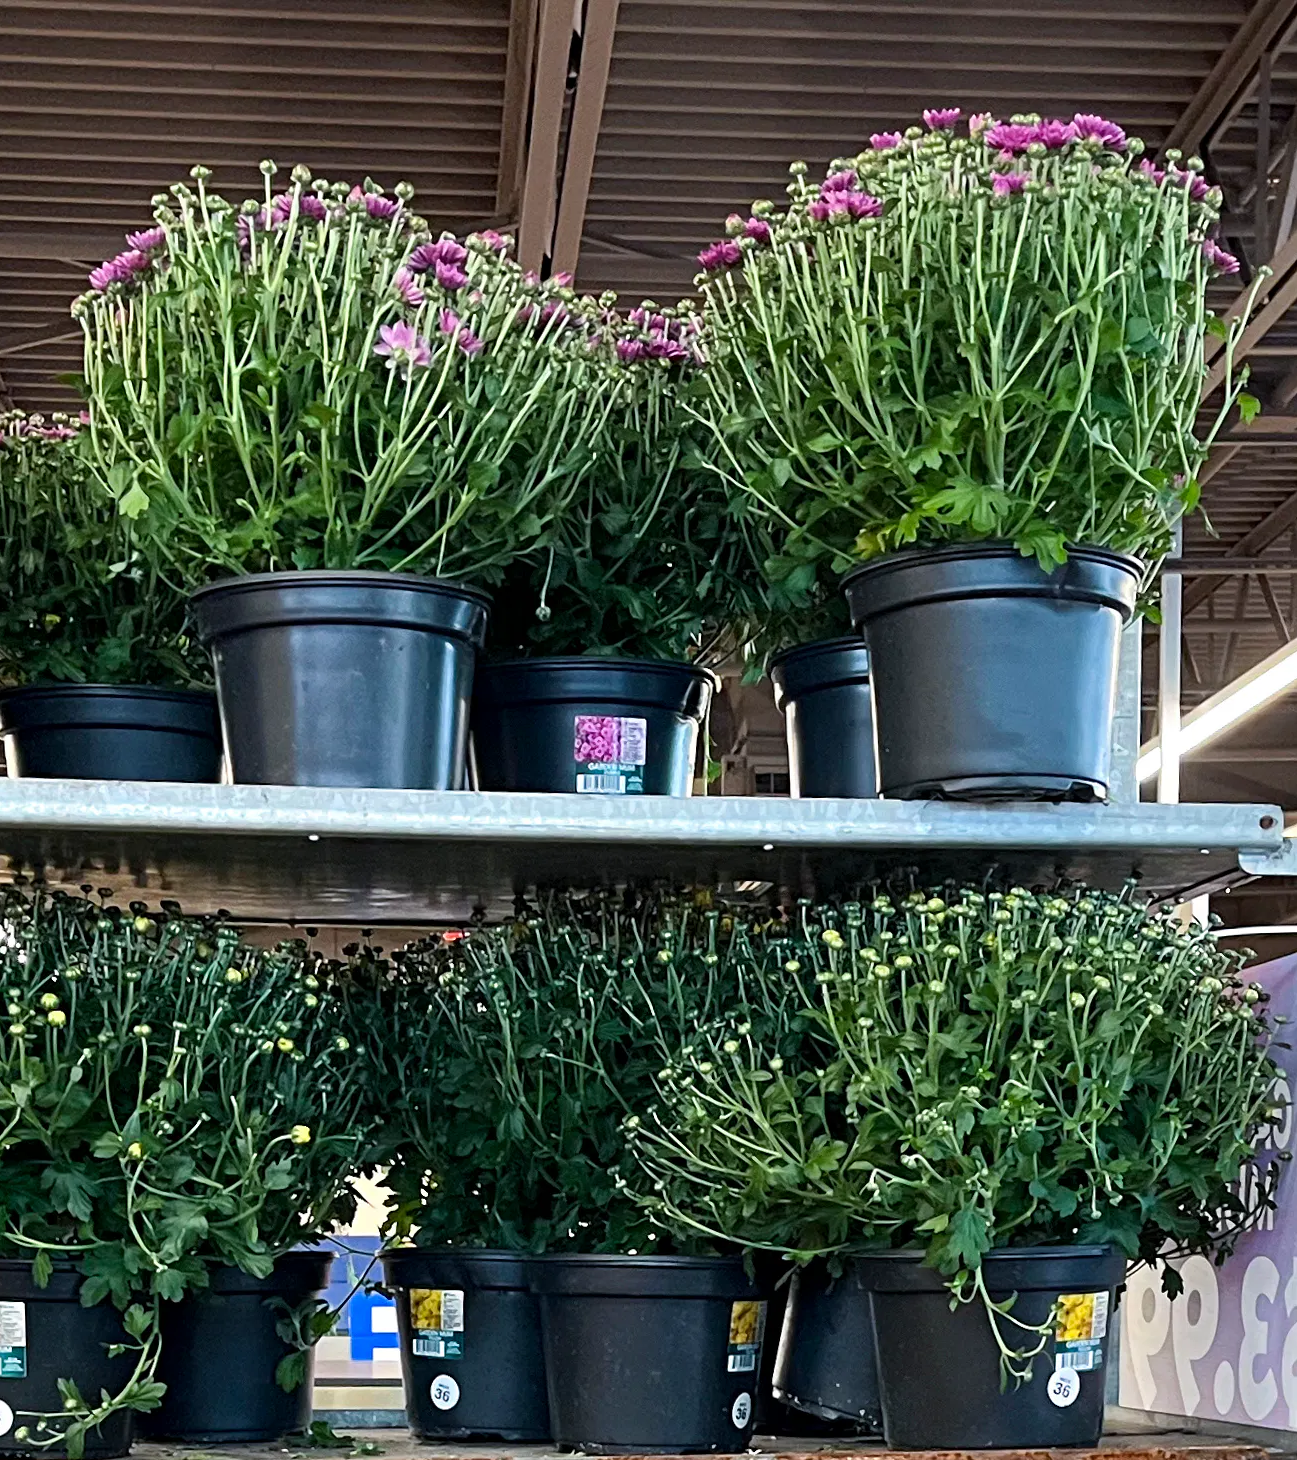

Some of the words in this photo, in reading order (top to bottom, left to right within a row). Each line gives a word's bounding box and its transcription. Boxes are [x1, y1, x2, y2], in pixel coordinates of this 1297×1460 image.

[434, 1388, 450, 1402] 36
[1053, 1382, 1071, 1398] 36
[736, 1408, 747, 1420] 36
